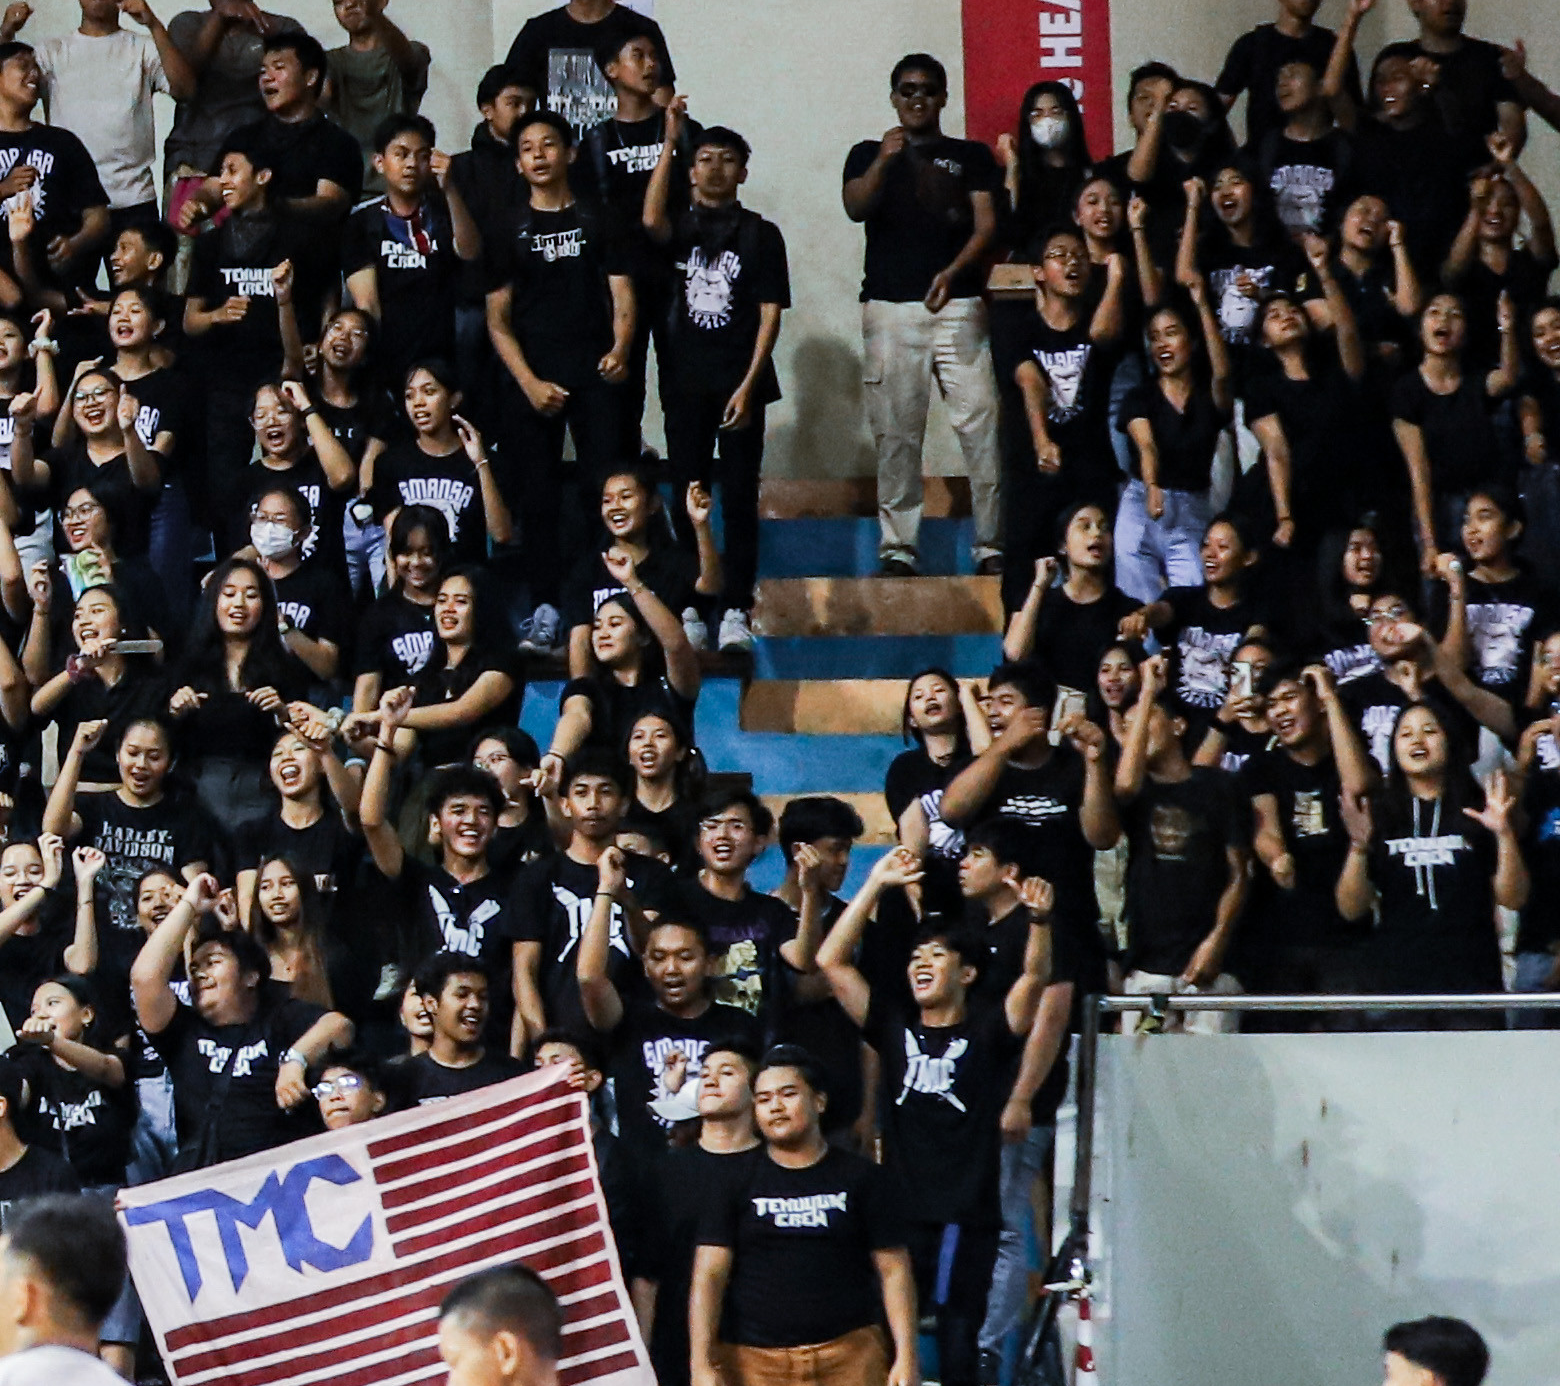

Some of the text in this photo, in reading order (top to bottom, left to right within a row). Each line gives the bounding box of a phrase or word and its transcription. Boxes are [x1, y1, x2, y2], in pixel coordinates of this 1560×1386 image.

[400, 477, 475, 510] SMANSA
[752, 1192, 847, 1217] TEMUYUK
[126, 1154, 374, 1303] TMC
[774, 1211, 829, 1228] CREW
